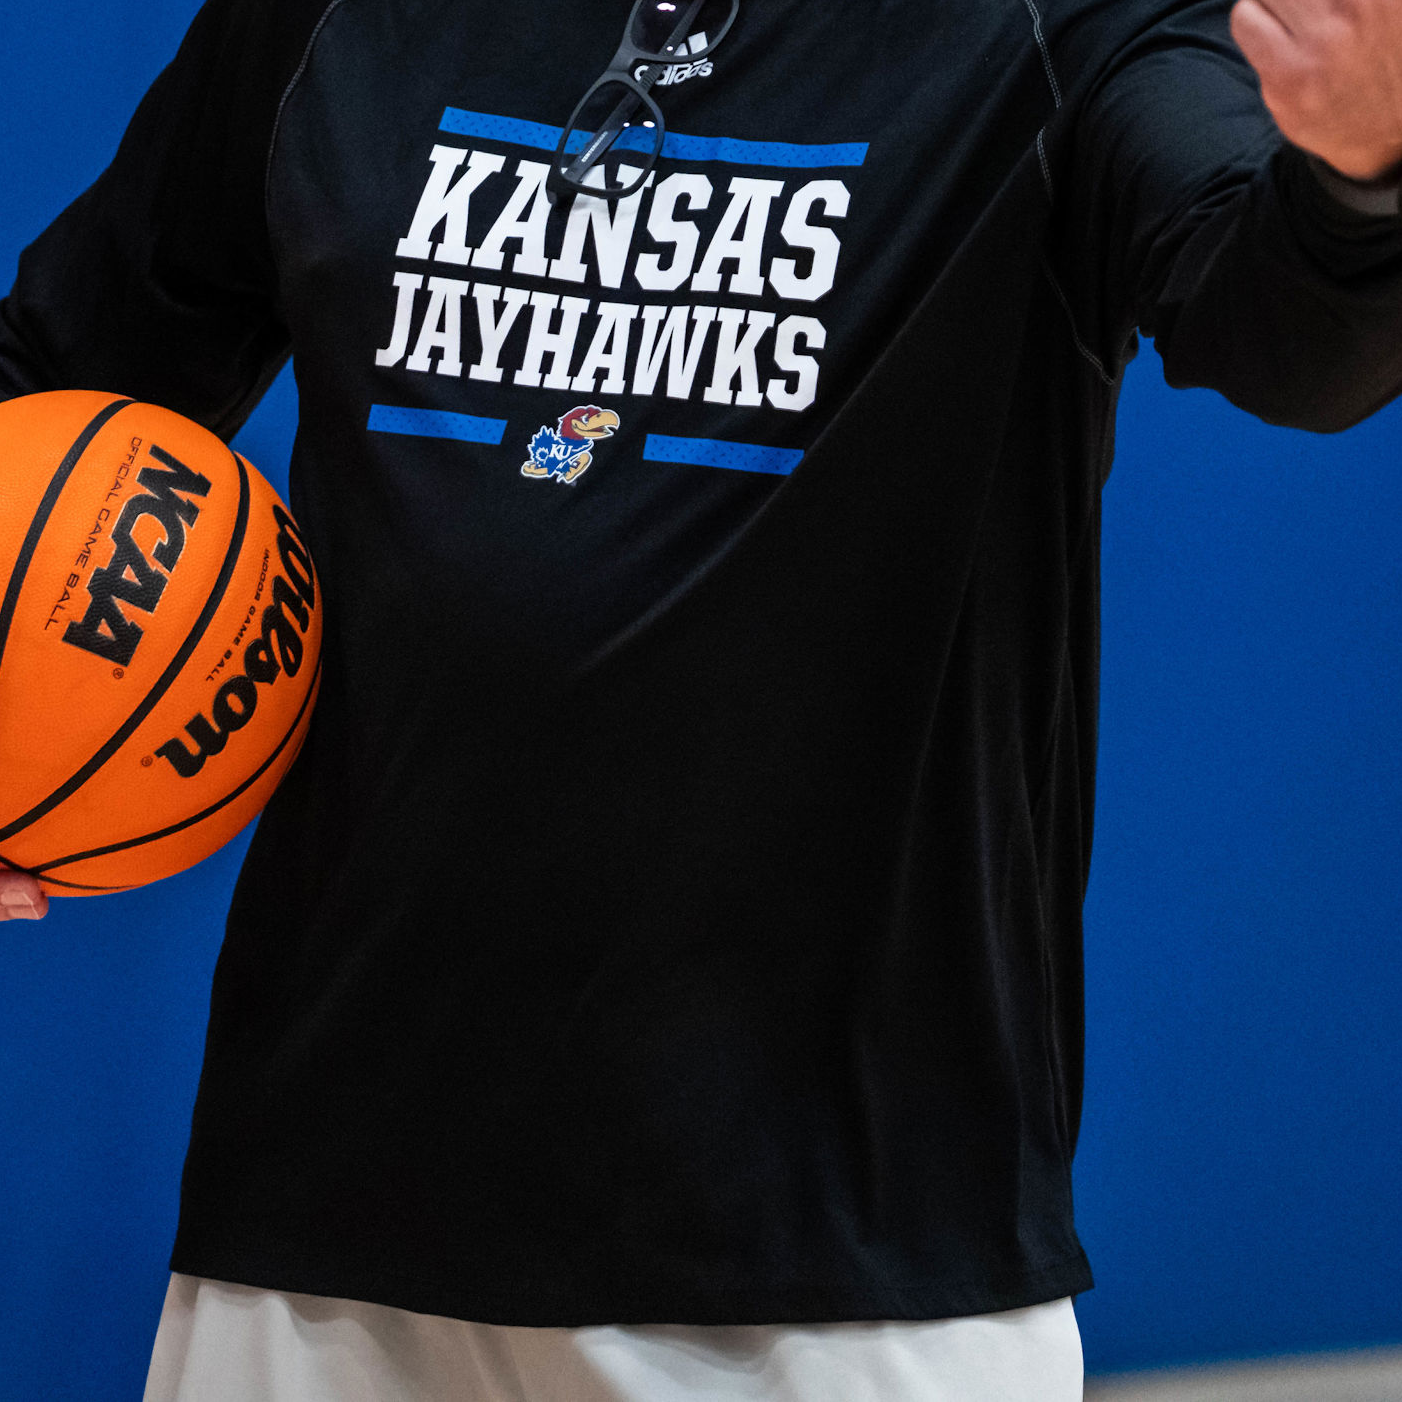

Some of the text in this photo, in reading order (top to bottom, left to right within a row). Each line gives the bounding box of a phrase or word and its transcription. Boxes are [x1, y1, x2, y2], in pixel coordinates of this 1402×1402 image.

[395, 144, 851, 302] KANSAS
[374, 272, 827, 412] JAYHAWKS
[548, 443, 573, 460] KU
[45, 436, 142, 630] OFFICIAL GAME BALL
[61, 443, 212, 667] NCAA
[154, 504, 315, 778] Wilson
[206, 548, 270, 682] INDOOR GAME BALL
